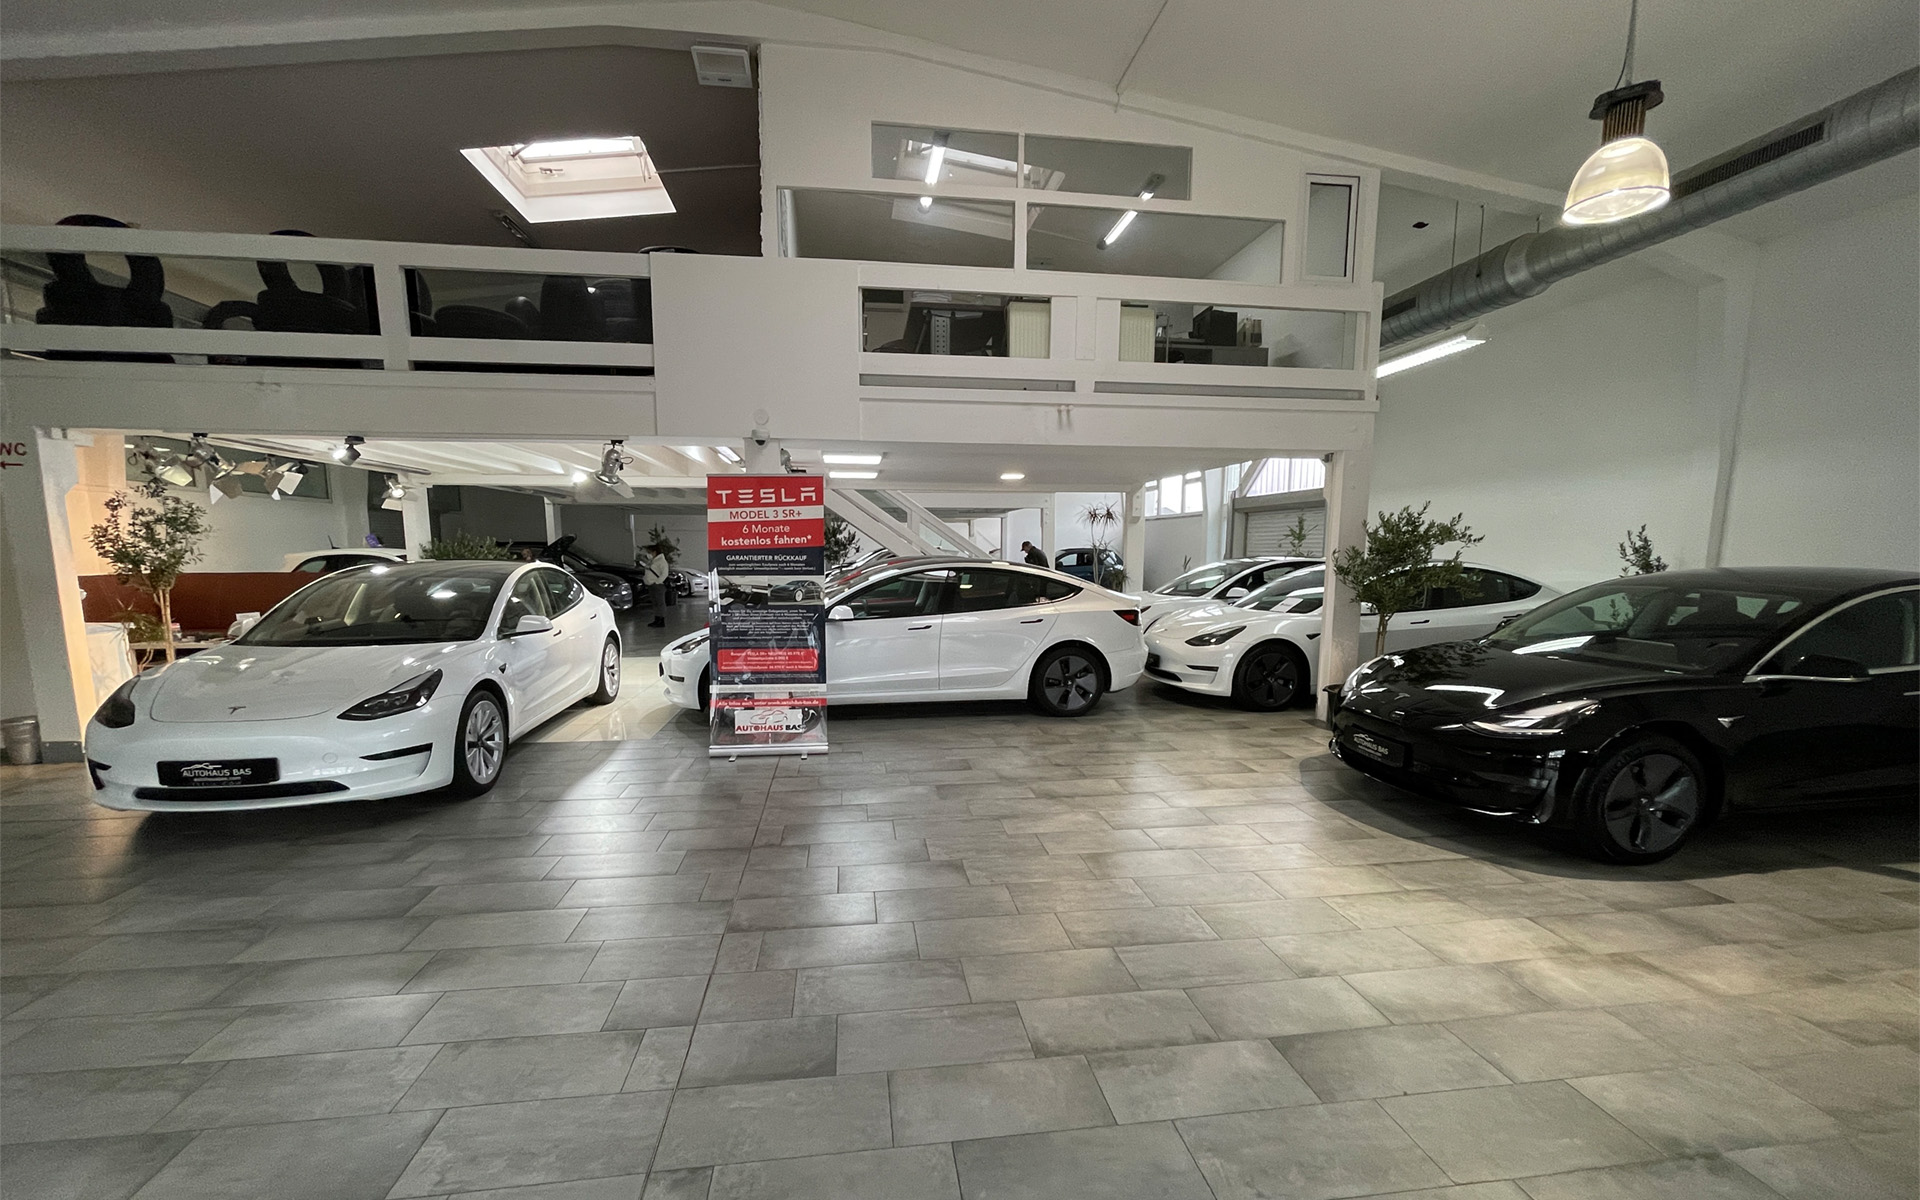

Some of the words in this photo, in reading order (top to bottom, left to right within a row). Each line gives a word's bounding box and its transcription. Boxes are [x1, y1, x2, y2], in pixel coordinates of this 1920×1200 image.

[715, 487, 816, 504] TESLA
[729, 510, 769, 520] MODEL
[773, 510, 779, 519] 3
[782, 509, 802, 518] SR+
[742, 525, 749, 534] 6
[752, 524, 790, 534] Monate
[721, 536, 771, 546] kostenlos
[735, 724, 783, 732] AUTOHAUS
[183, 769, 230, 777] AUTOHAUS
[233, 768, 252, 776] BAS
